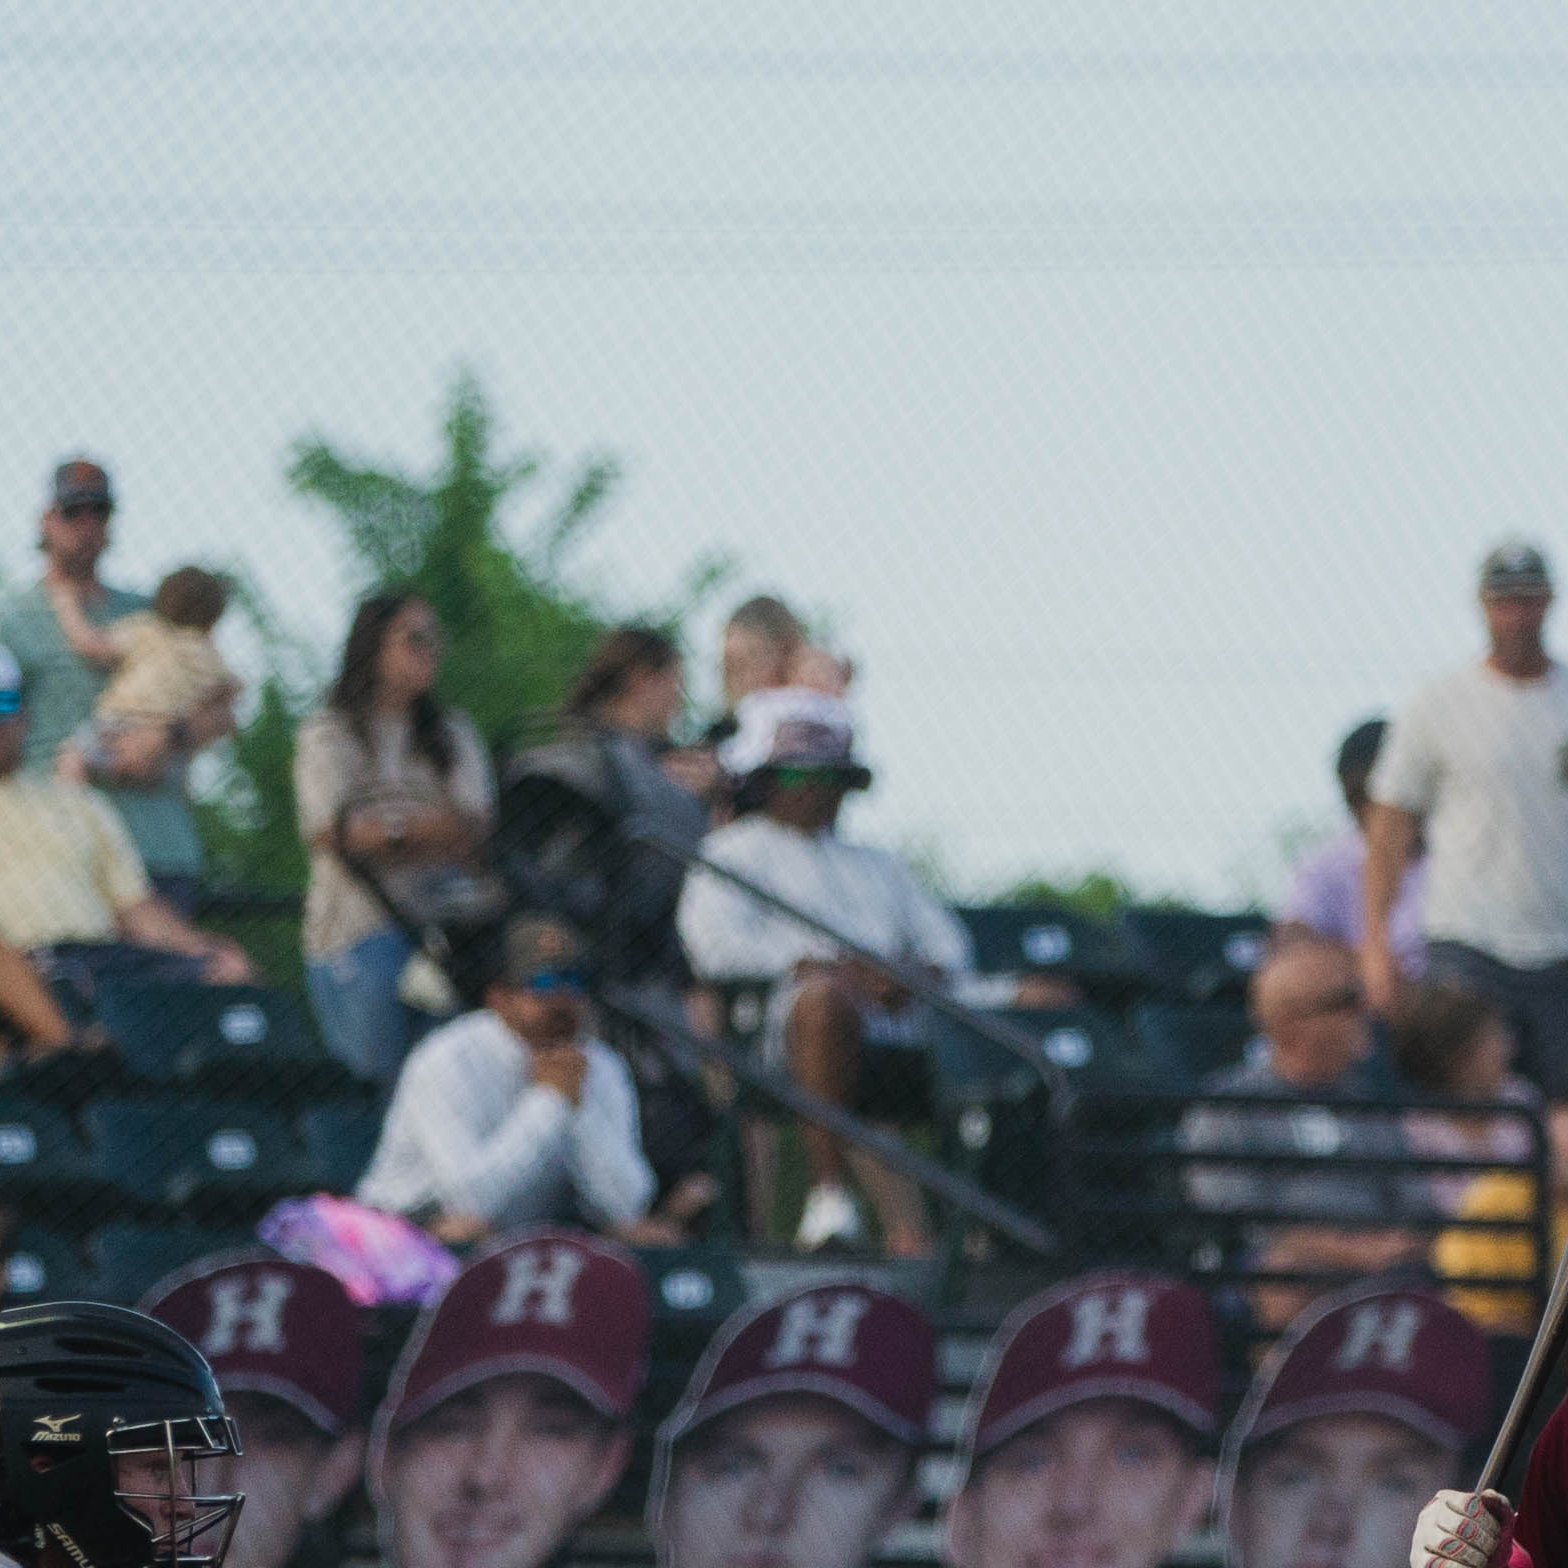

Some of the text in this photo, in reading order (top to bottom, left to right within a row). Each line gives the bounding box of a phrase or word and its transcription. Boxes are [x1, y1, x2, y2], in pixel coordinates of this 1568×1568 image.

[201, 1273, 293, 1355] H
[490, 1245, 584, 1325] H
[765, 1293, 869, 1366] H
[1062, 1287, 1155, 1366] H
[1333, 1302, 1422, 1371] H
